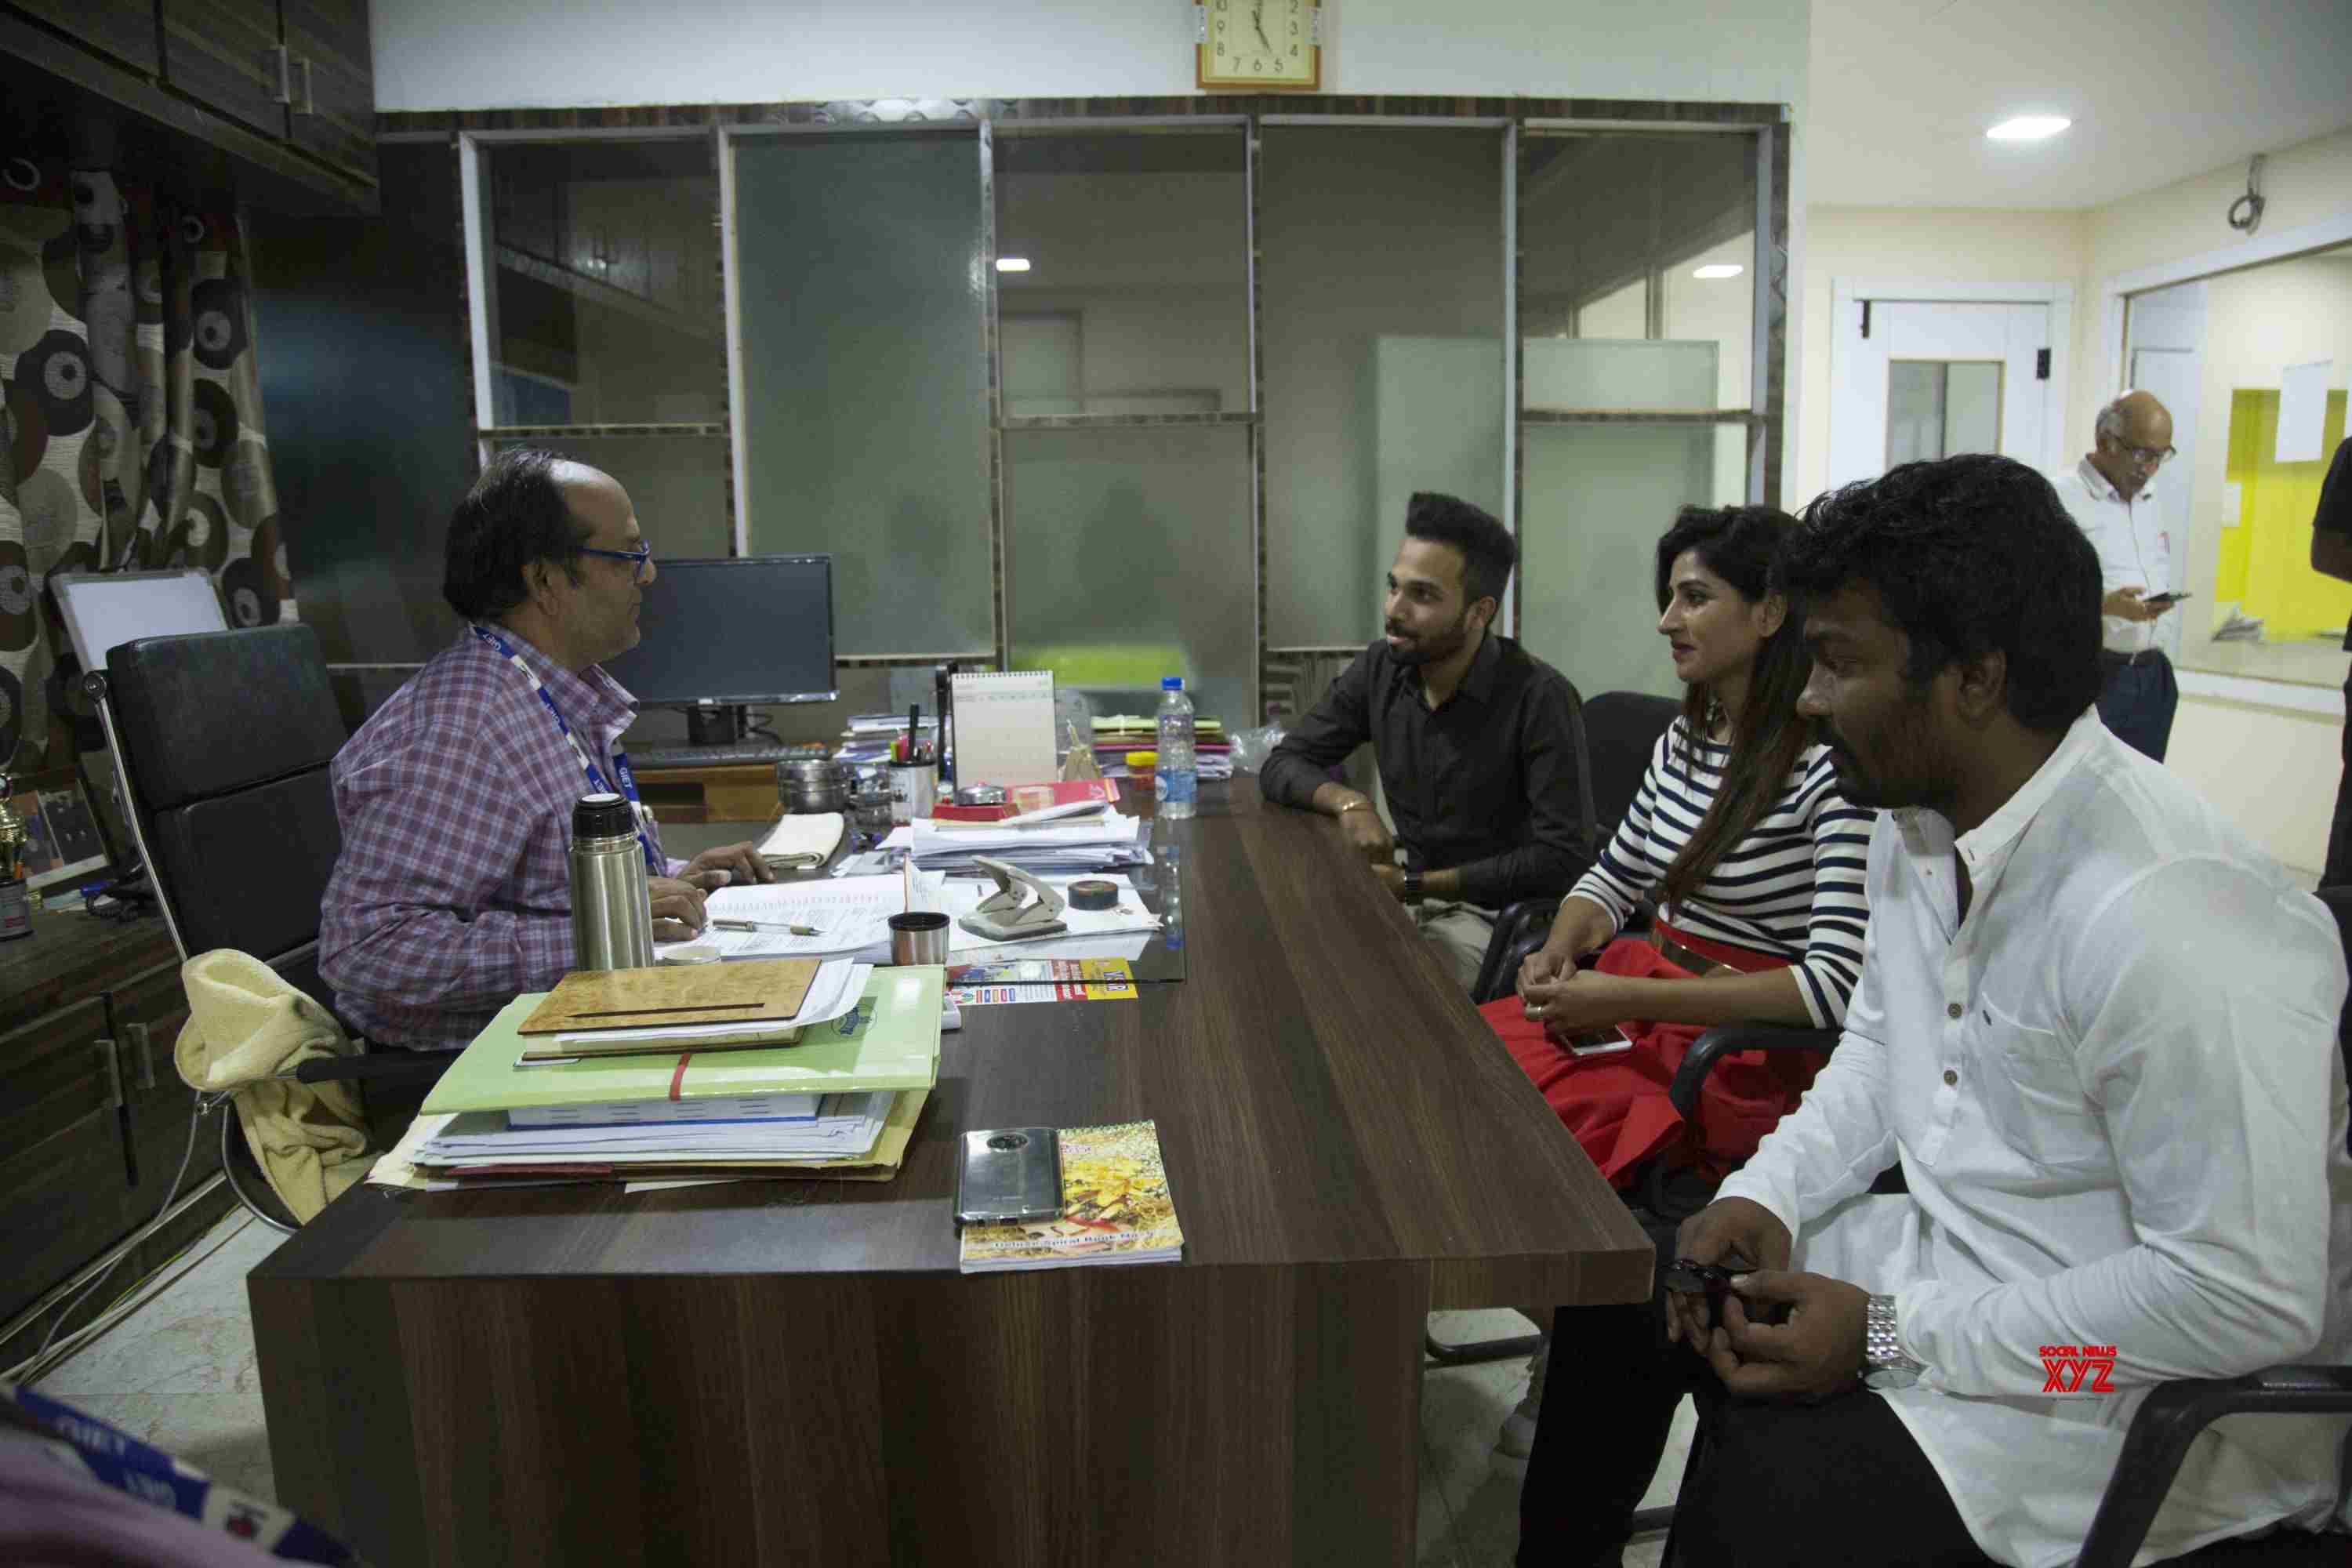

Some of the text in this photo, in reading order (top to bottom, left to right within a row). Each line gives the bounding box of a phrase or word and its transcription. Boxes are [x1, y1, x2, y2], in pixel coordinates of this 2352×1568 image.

[1217, 20, 1225, 34] 9
[1290, 20, 1299, 35] 3
[1217, 42, 1225, 56] 8
[1289, 43, 1299, 56] 4
[1233, 56, 1242, 72] 7
[1254, 59, 1263, 71] 6
[1274, 57, 1284, 73] 5
